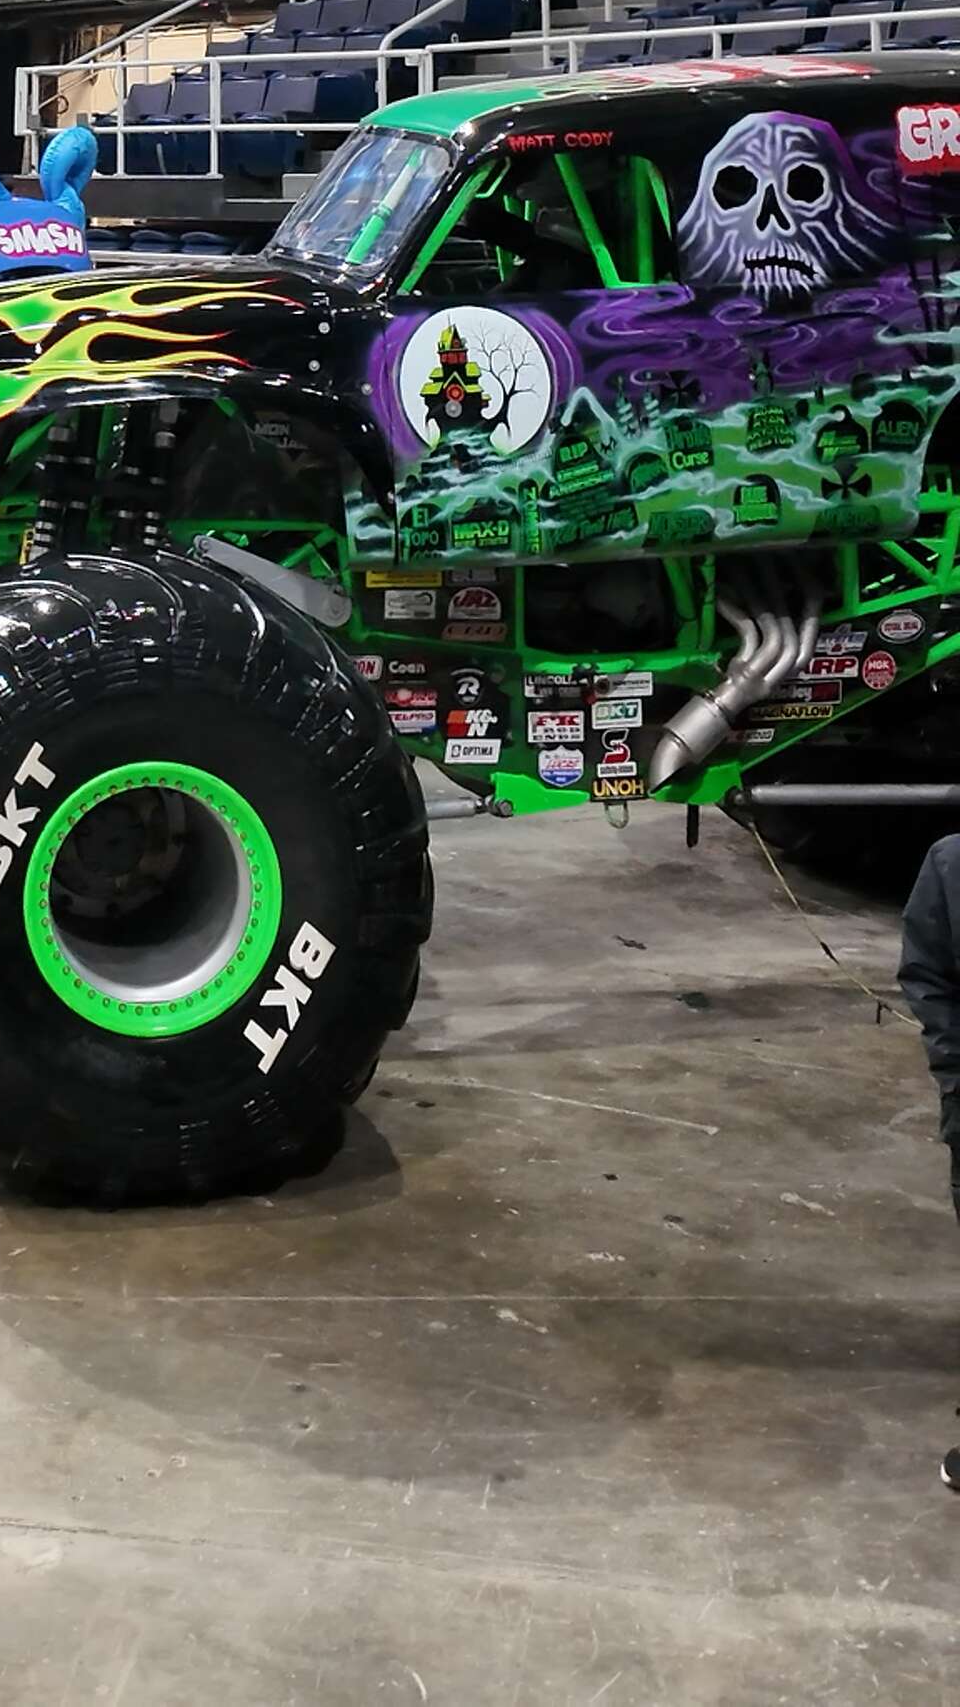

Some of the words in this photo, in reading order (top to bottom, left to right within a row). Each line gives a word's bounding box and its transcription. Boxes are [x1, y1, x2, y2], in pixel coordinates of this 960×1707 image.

[505, 134, 556, 152] MATT
[564, 131, 614, 148] CODY
[876, 421, 920, 437] ALIEN
[559, 441, 588, 463] RIP
[672, 451, 709, 470] Curse
[389, 660, 424, 674] Coan
[868, 660, 890, 671] NGK
[462, 746, 493, 756] OPTIMA
[592, 779, 644, 796] UNOH
[242, 921, 338, 1074] BKT
